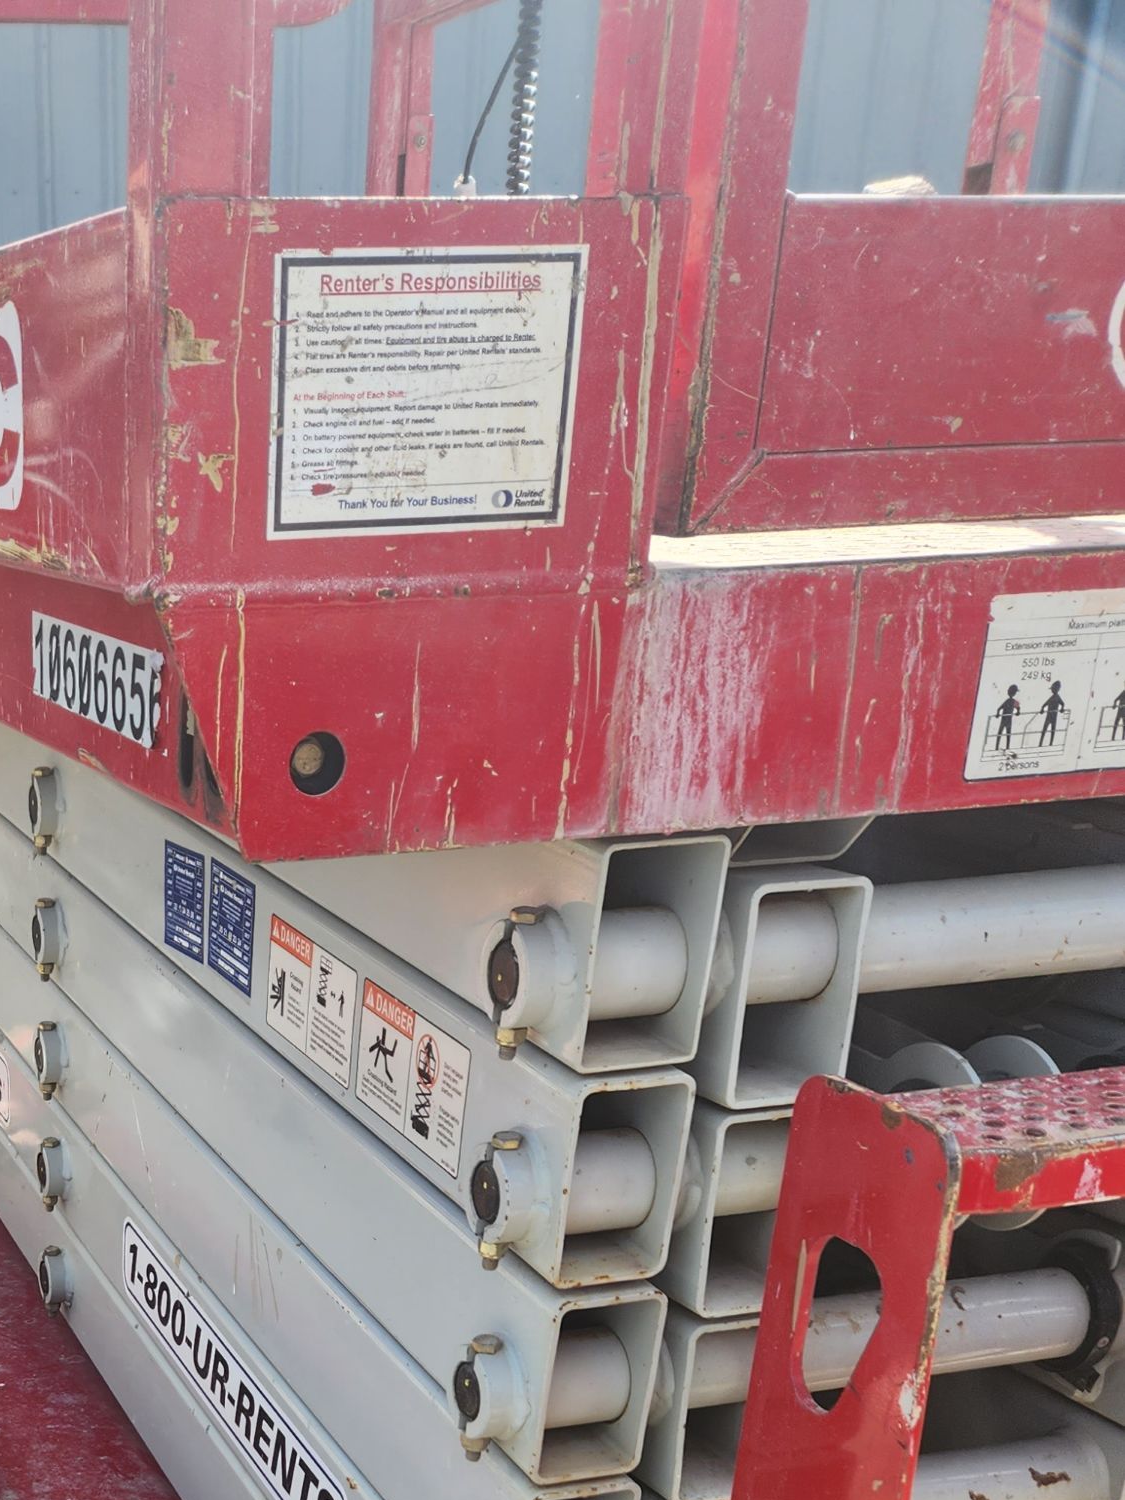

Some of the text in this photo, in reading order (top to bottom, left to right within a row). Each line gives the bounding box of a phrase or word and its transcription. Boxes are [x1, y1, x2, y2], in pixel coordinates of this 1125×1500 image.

[319, 270, 541, 294] Renter's Responsibilities
[469, 306, 503, 315] equipment
[306, 325, 329, 334] Strictly
[362, 323, 381, 332] safety
[384, 322, 422, 332] precautions
[446, 348, 456, 357] per
[317, 392, 355, 402] Beginning
[303, 407, 328, 416] Visually
[393, 404, 416, 413] Report
[417, 403, 442, 412] damage
[325, 419, 347, 428] engine
[314, 433, 336, 442] battery
[338, 432, 365, 441] powered
[515, 489, 544, 498] United
[337, 494, 477, 509] Thank You for Your Business!
[513, 497, 545, 506] Rentals
[1068, 621, 1107, 630] Maximum
[1005, 638, 1077, 651] Extension retracted
[1021, 656, 1055, 668] 550 lbs
[1021, 670, 1052, 682] 249 kg
[998, 760, 1040, 771] 2 persons
[280, 924, 310, 961] DANGER
[375, 992, 414, 1035] DANGER
